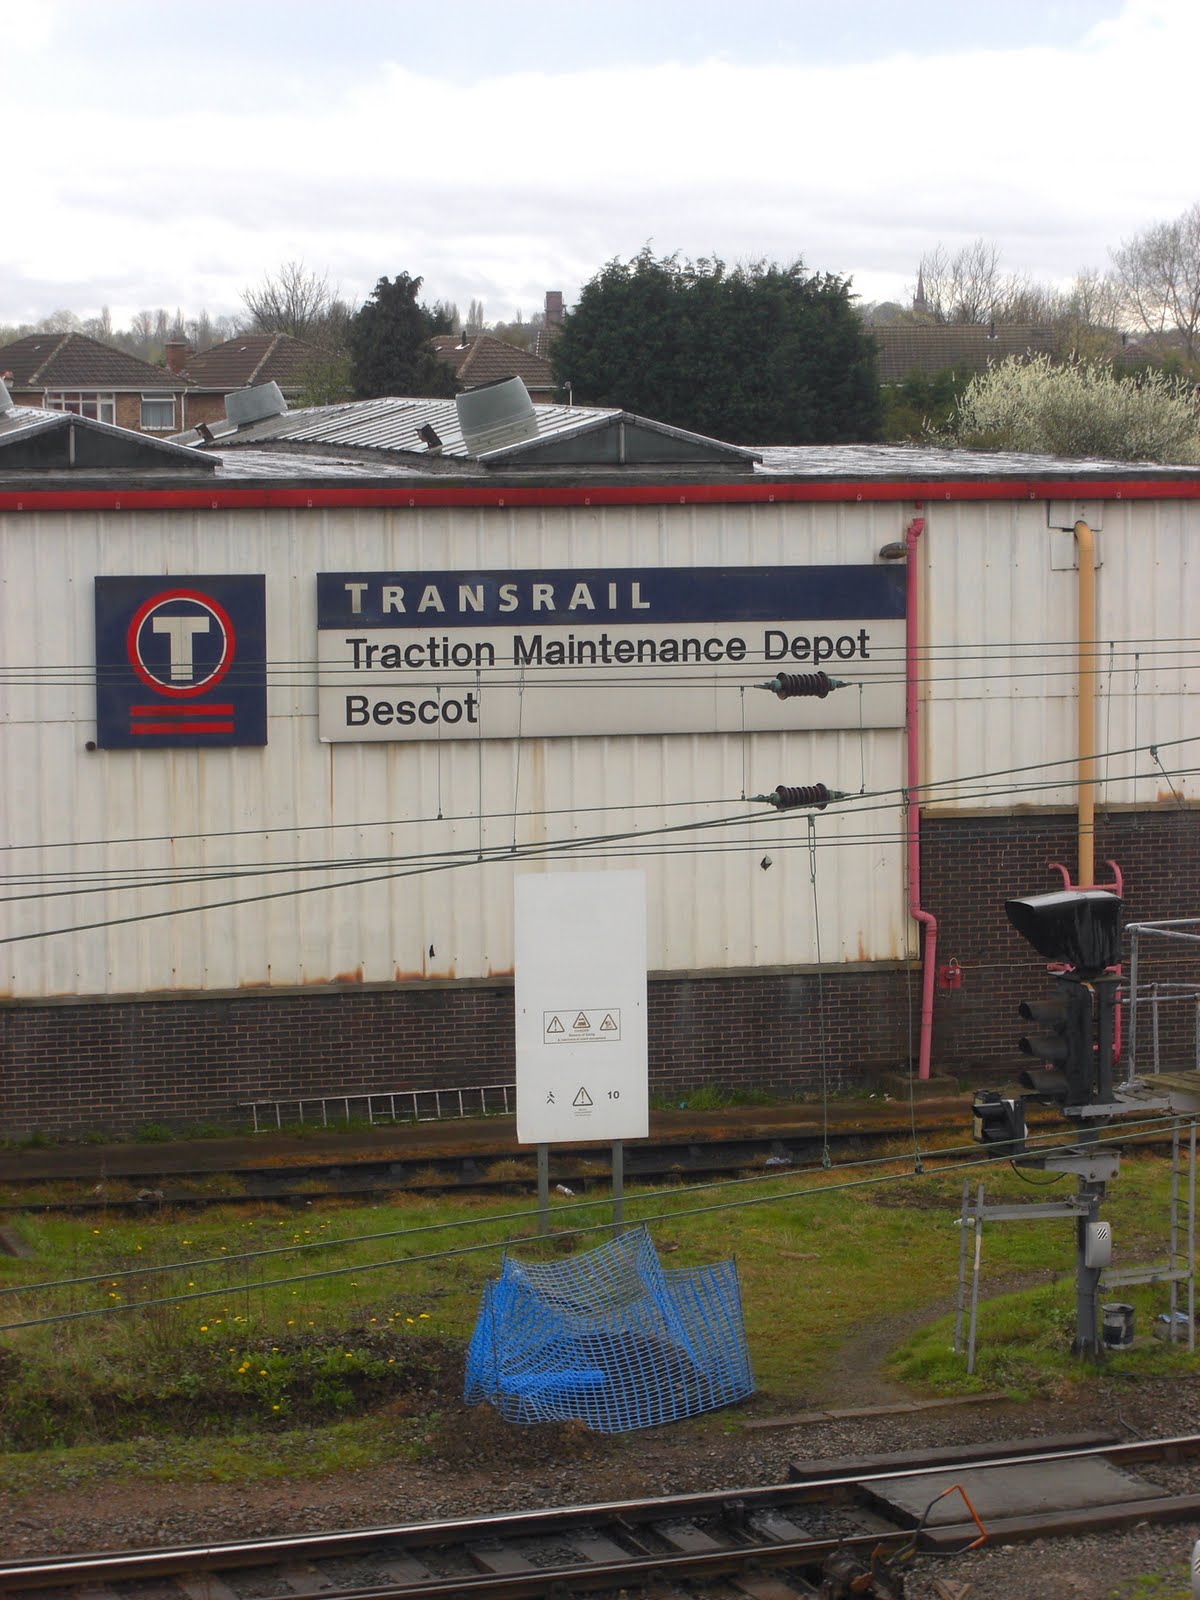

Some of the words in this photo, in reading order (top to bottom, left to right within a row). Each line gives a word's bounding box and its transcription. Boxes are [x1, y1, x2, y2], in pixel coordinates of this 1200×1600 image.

[345, 583, 651, 614] TRANSRAIL
[152, 616, 210, 681] T
[345, 637, 495, 669] Traction
[513, 633, 747, 666] Maintenance
[764, 629, 870, 666] Depot
[345, 693, 478, 726] Bescot
[607, 1090, 620, 1100] 10
